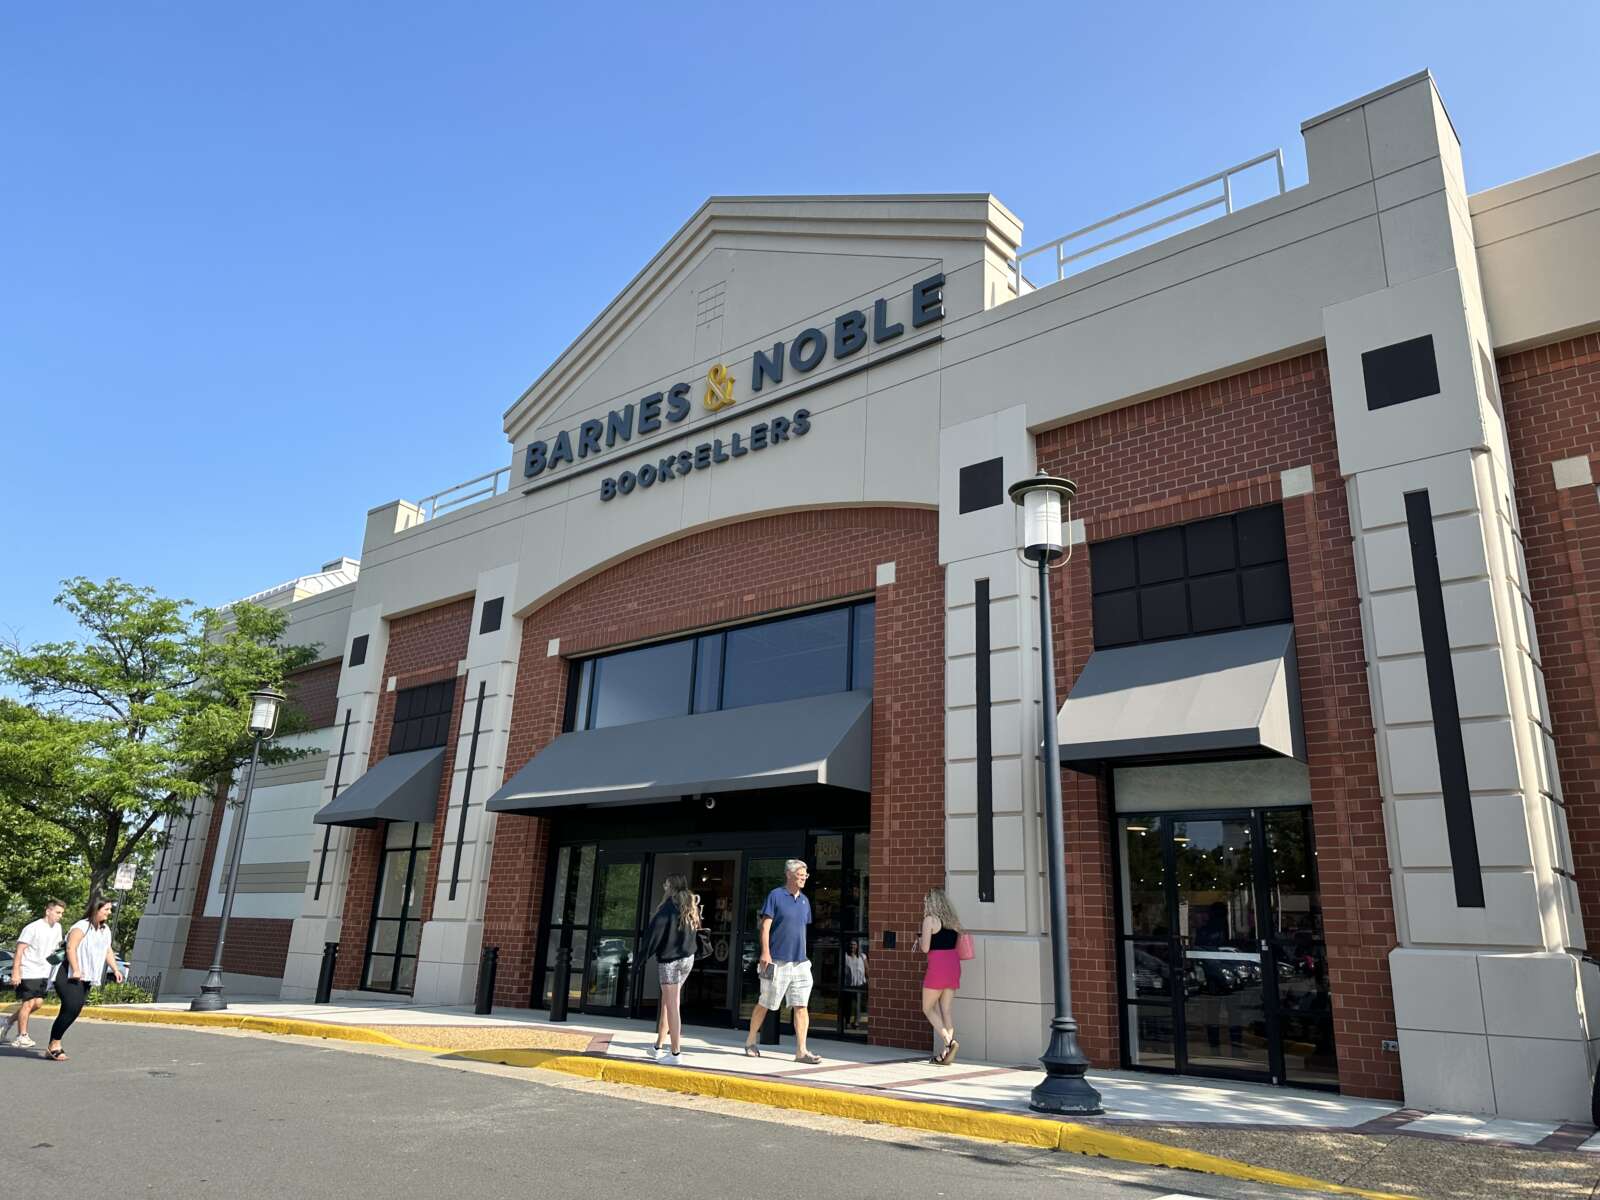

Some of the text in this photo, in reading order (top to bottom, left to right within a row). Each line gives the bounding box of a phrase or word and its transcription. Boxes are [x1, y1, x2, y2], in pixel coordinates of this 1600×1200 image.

[523, 272, 946, 478] BARNES & NOBLE
[600, 408, 812, 501] BOOKSELLERS
